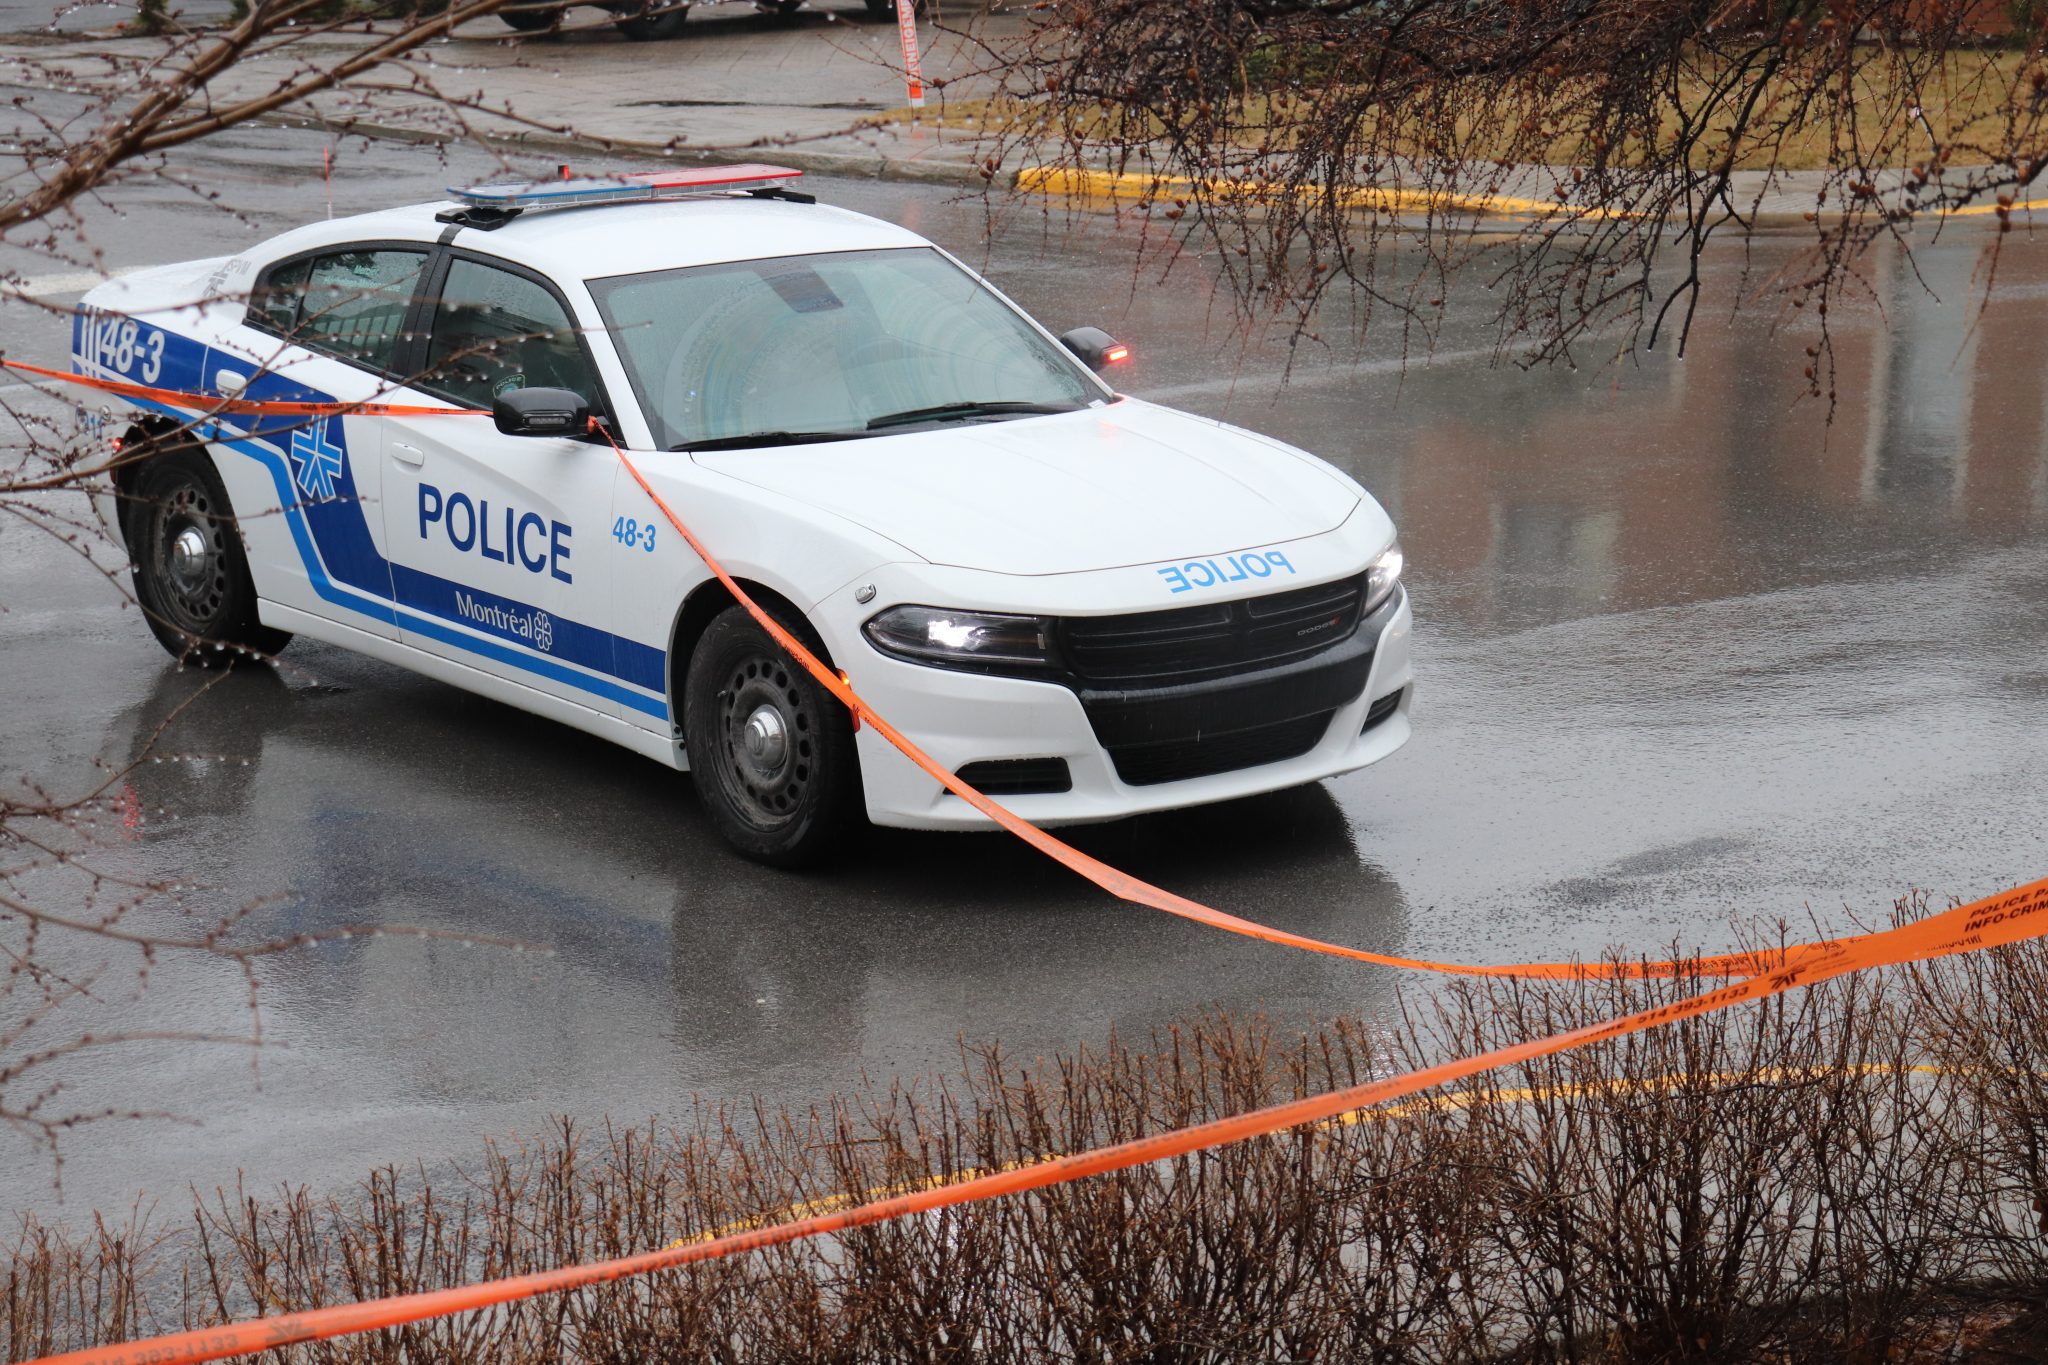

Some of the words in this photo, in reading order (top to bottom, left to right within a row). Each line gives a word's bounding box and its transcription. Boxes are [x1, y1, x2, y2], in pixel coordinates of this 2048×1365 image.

[101, 317, 165, 384] 48-3
[418, 483, 573, 585] POLICE
[612, 516, 657, 553] 48-3
[455, 589, 533, 639] Montréal
[1970, 893, 2031, 919] POLICE
[1637, 1005, 1668, 1026] 514
[1673, 986, 1749, 1015] 393-1133
